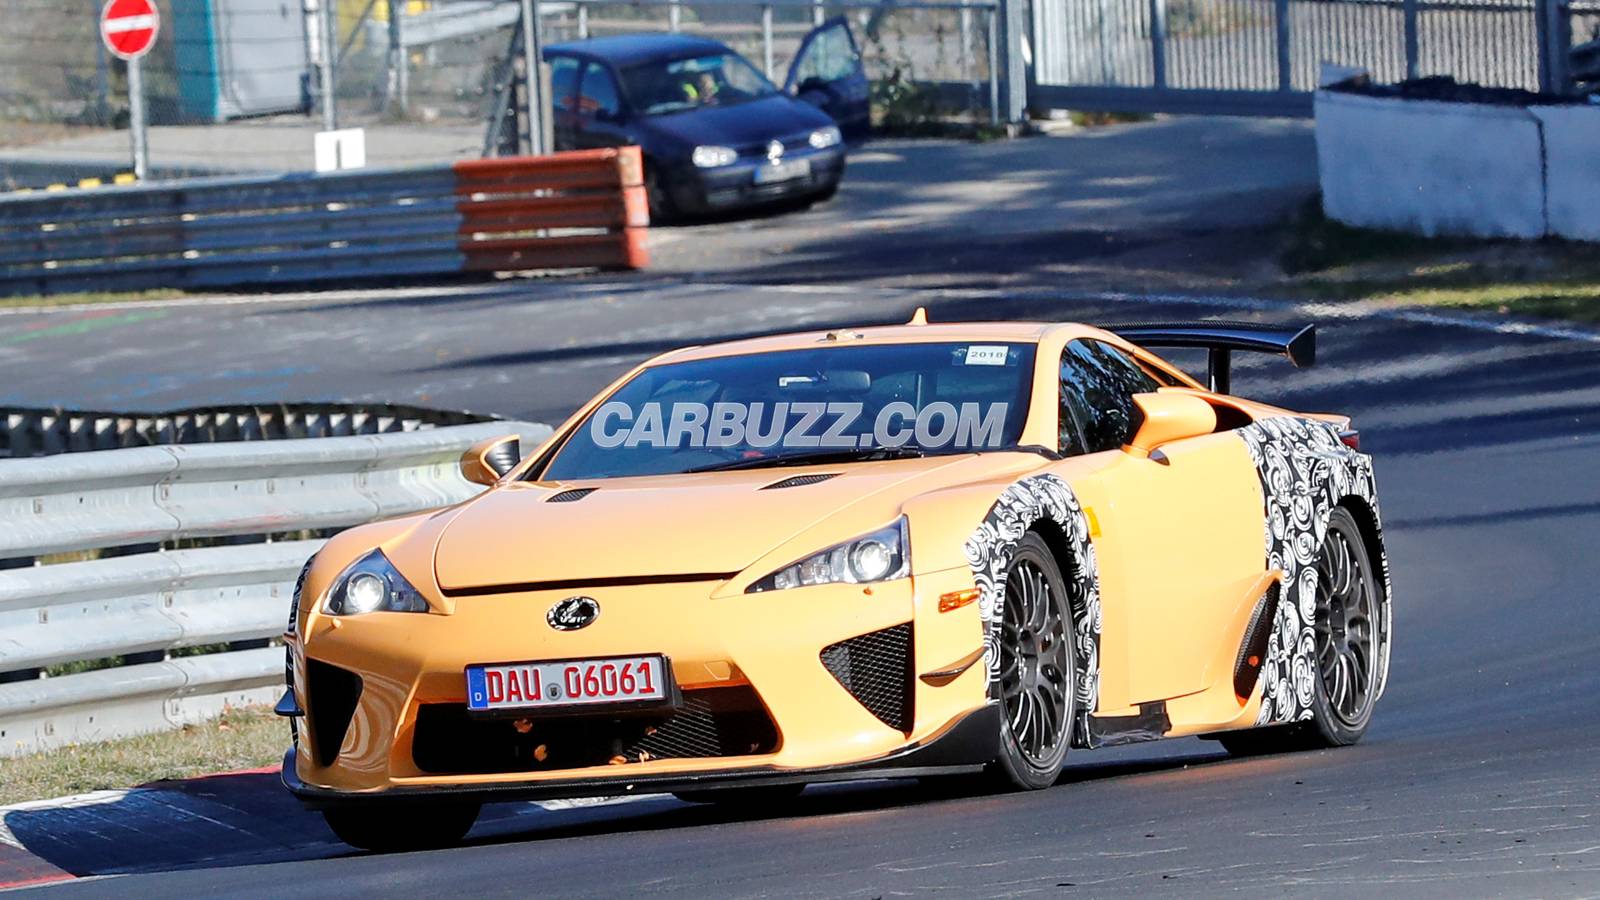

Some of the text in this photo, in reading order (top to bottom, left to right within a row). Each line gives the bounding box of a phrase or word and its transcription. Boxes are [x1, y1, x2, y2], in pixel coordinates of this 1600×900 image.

[487, 661, 655, 702] DAU 06061
[474, 692, 482, 701] D
